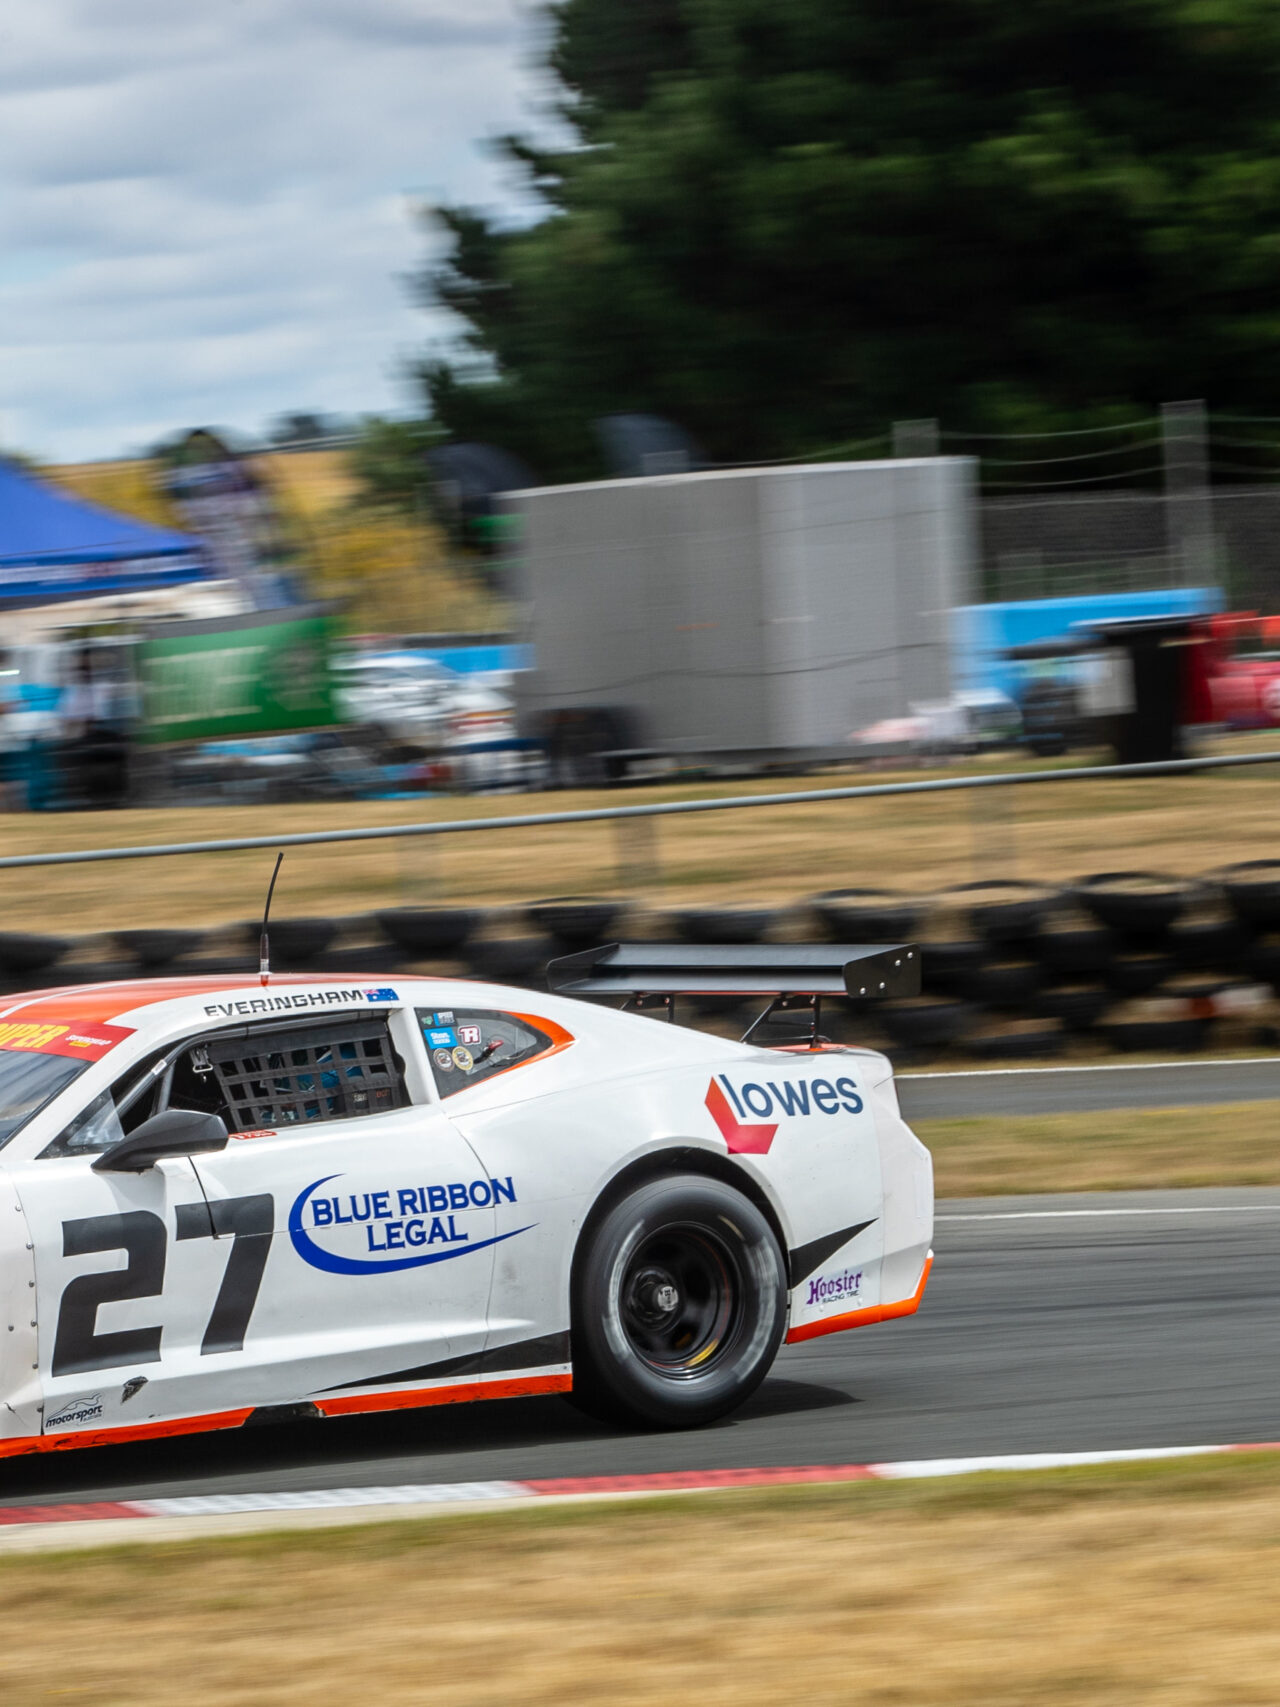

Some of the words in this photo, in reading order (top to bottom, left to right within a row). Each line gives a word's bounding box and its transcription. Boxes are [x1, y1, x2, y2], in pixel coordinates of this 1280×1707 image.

[204, 990, 364, 1017] EVERINGHAM
[718, 1074, 863, 1118] lowes
[311, 1191, 392, 1226] BLUE
[397, 1177, 517, 1216] RIBBON
[366, 1215, 468, 1252] LEGAL
[51, 1193, 275, 1378] 27
[806, 1269, 862, 1304] Hoosier
[46, 1405, 103, 1428] motorsport
